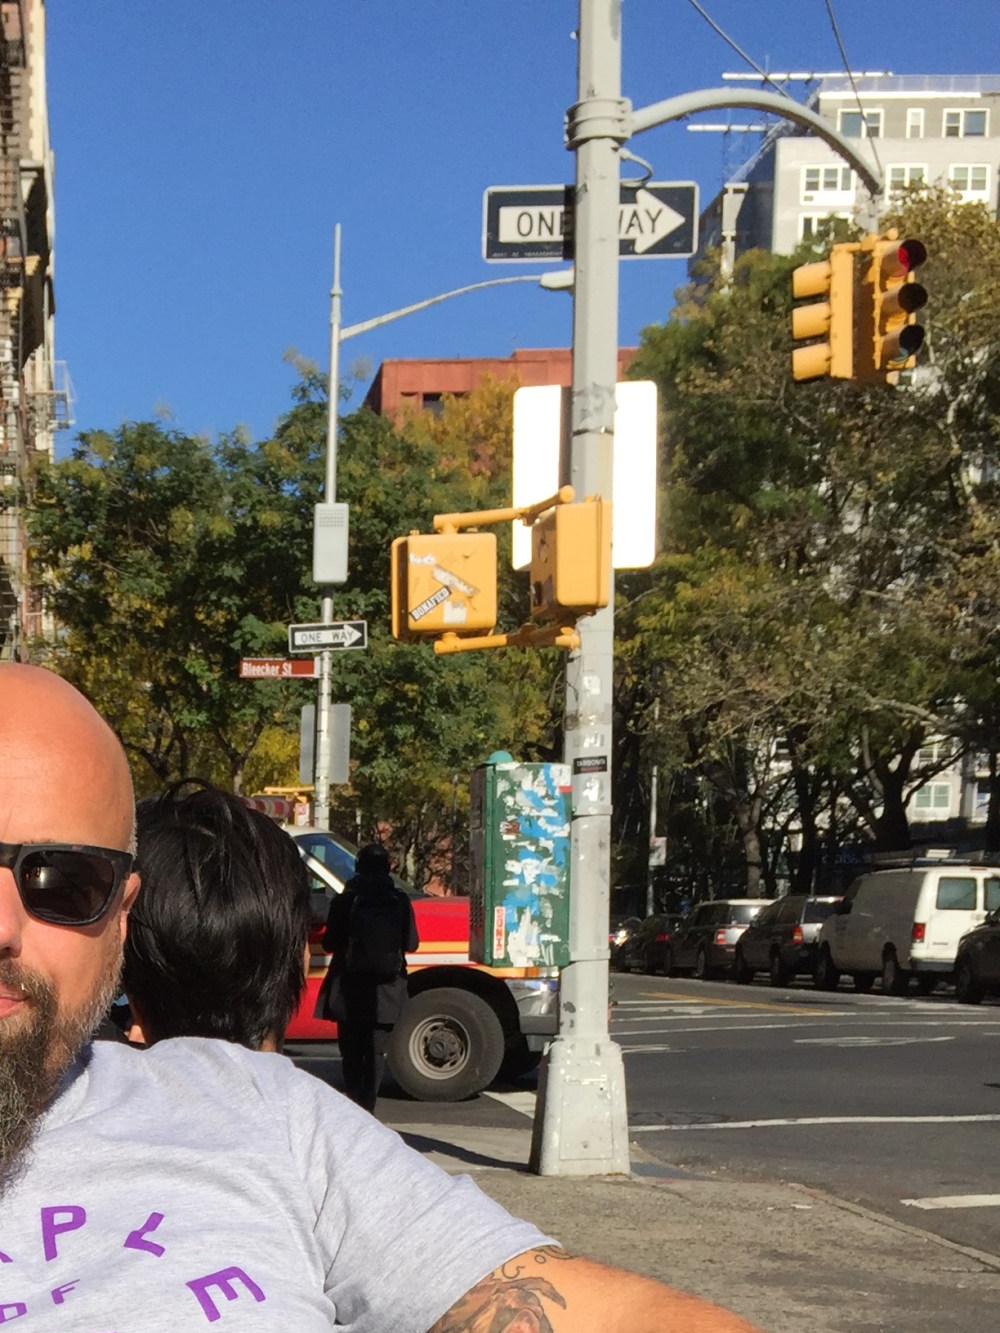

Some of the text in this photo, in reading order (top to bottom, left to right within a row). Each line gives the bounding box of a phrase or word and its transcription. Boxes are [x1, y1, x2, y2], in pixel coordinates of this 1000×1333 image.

[300, 630, 354, 644] ONE WAY
[242, 661, 292, 676] Bleecker St
